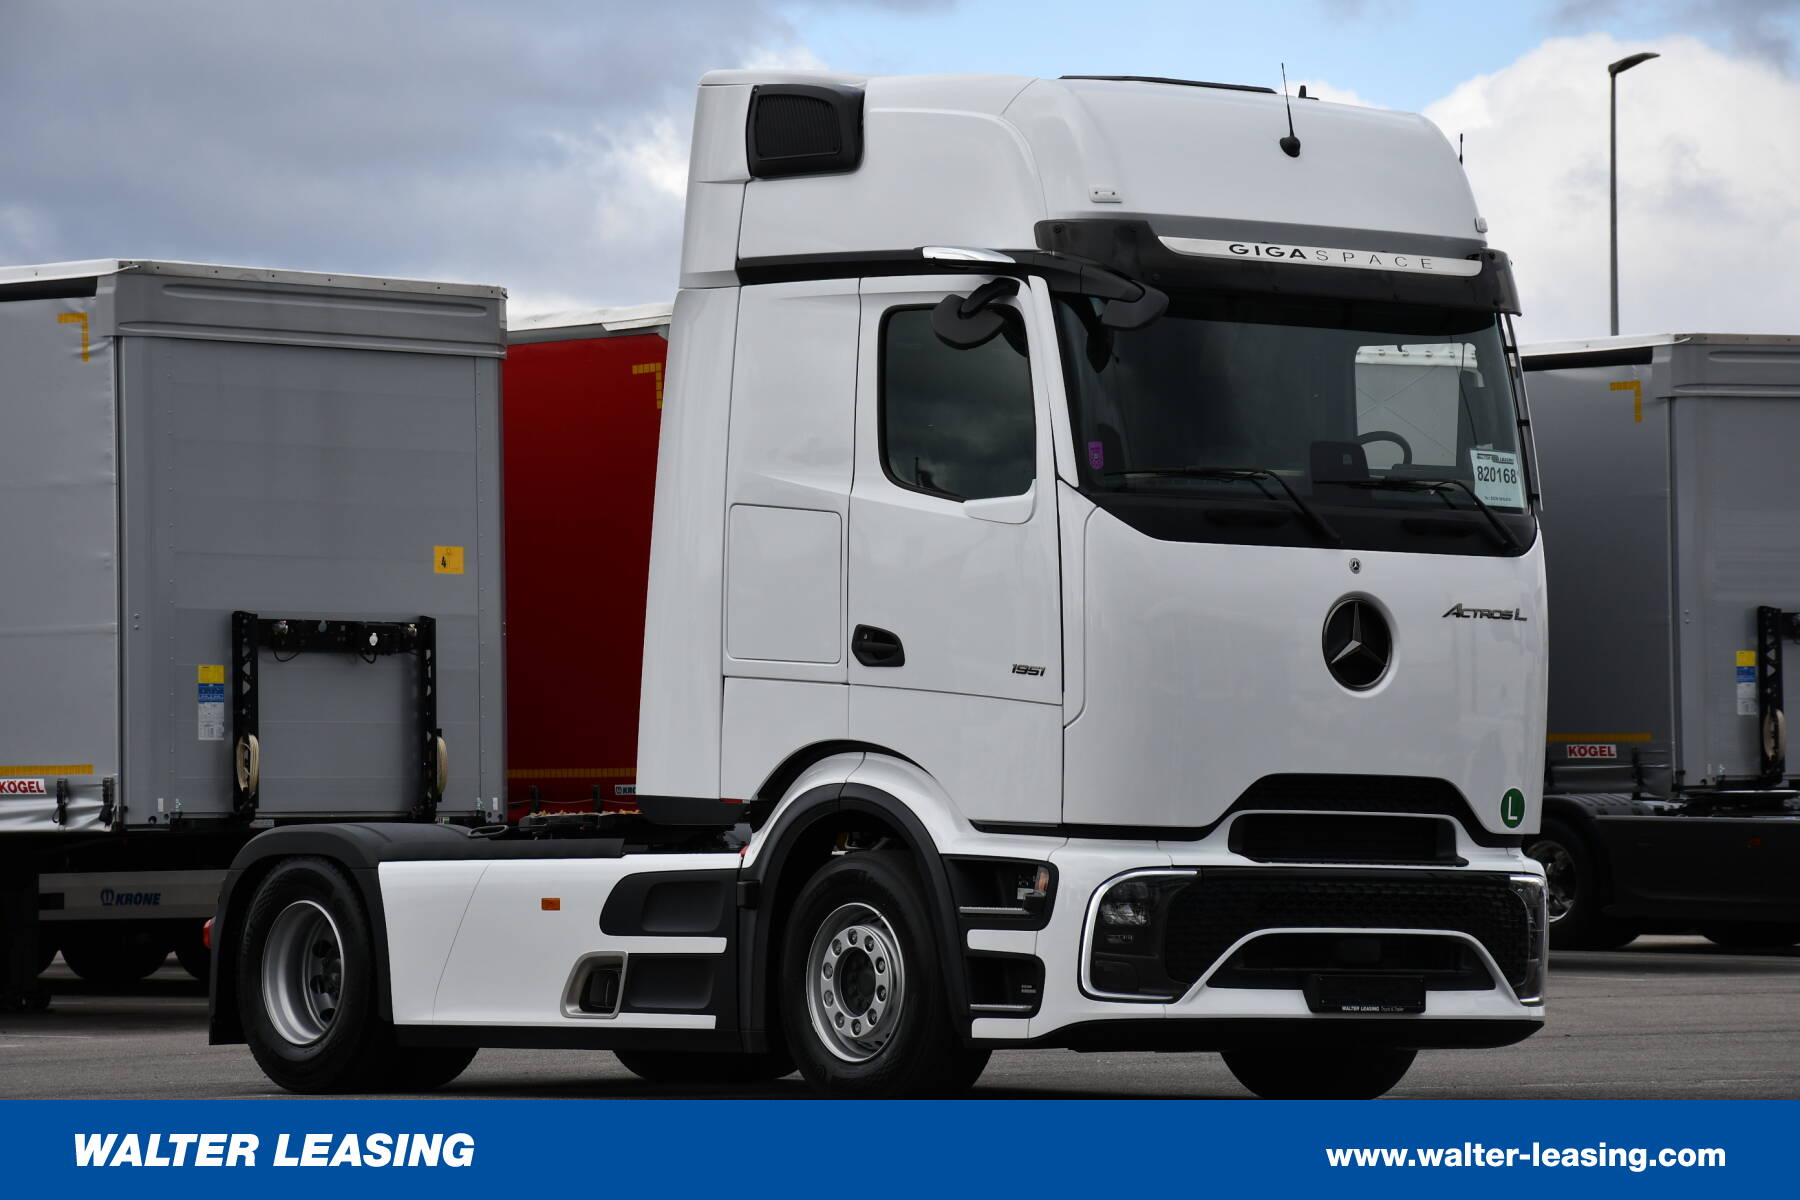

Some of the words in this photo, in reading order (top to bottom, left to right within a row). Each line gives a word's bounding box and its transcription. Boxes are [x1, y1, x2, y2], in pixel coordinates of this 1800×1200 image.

[1477, 465, 1517, 484] 820168
[1514, 608, 1527, 621] L
[1011, 663, 1046, 677] 1951
[1507, 796, 1518, 820] L
[115, 892, 161, 906] KRONE
